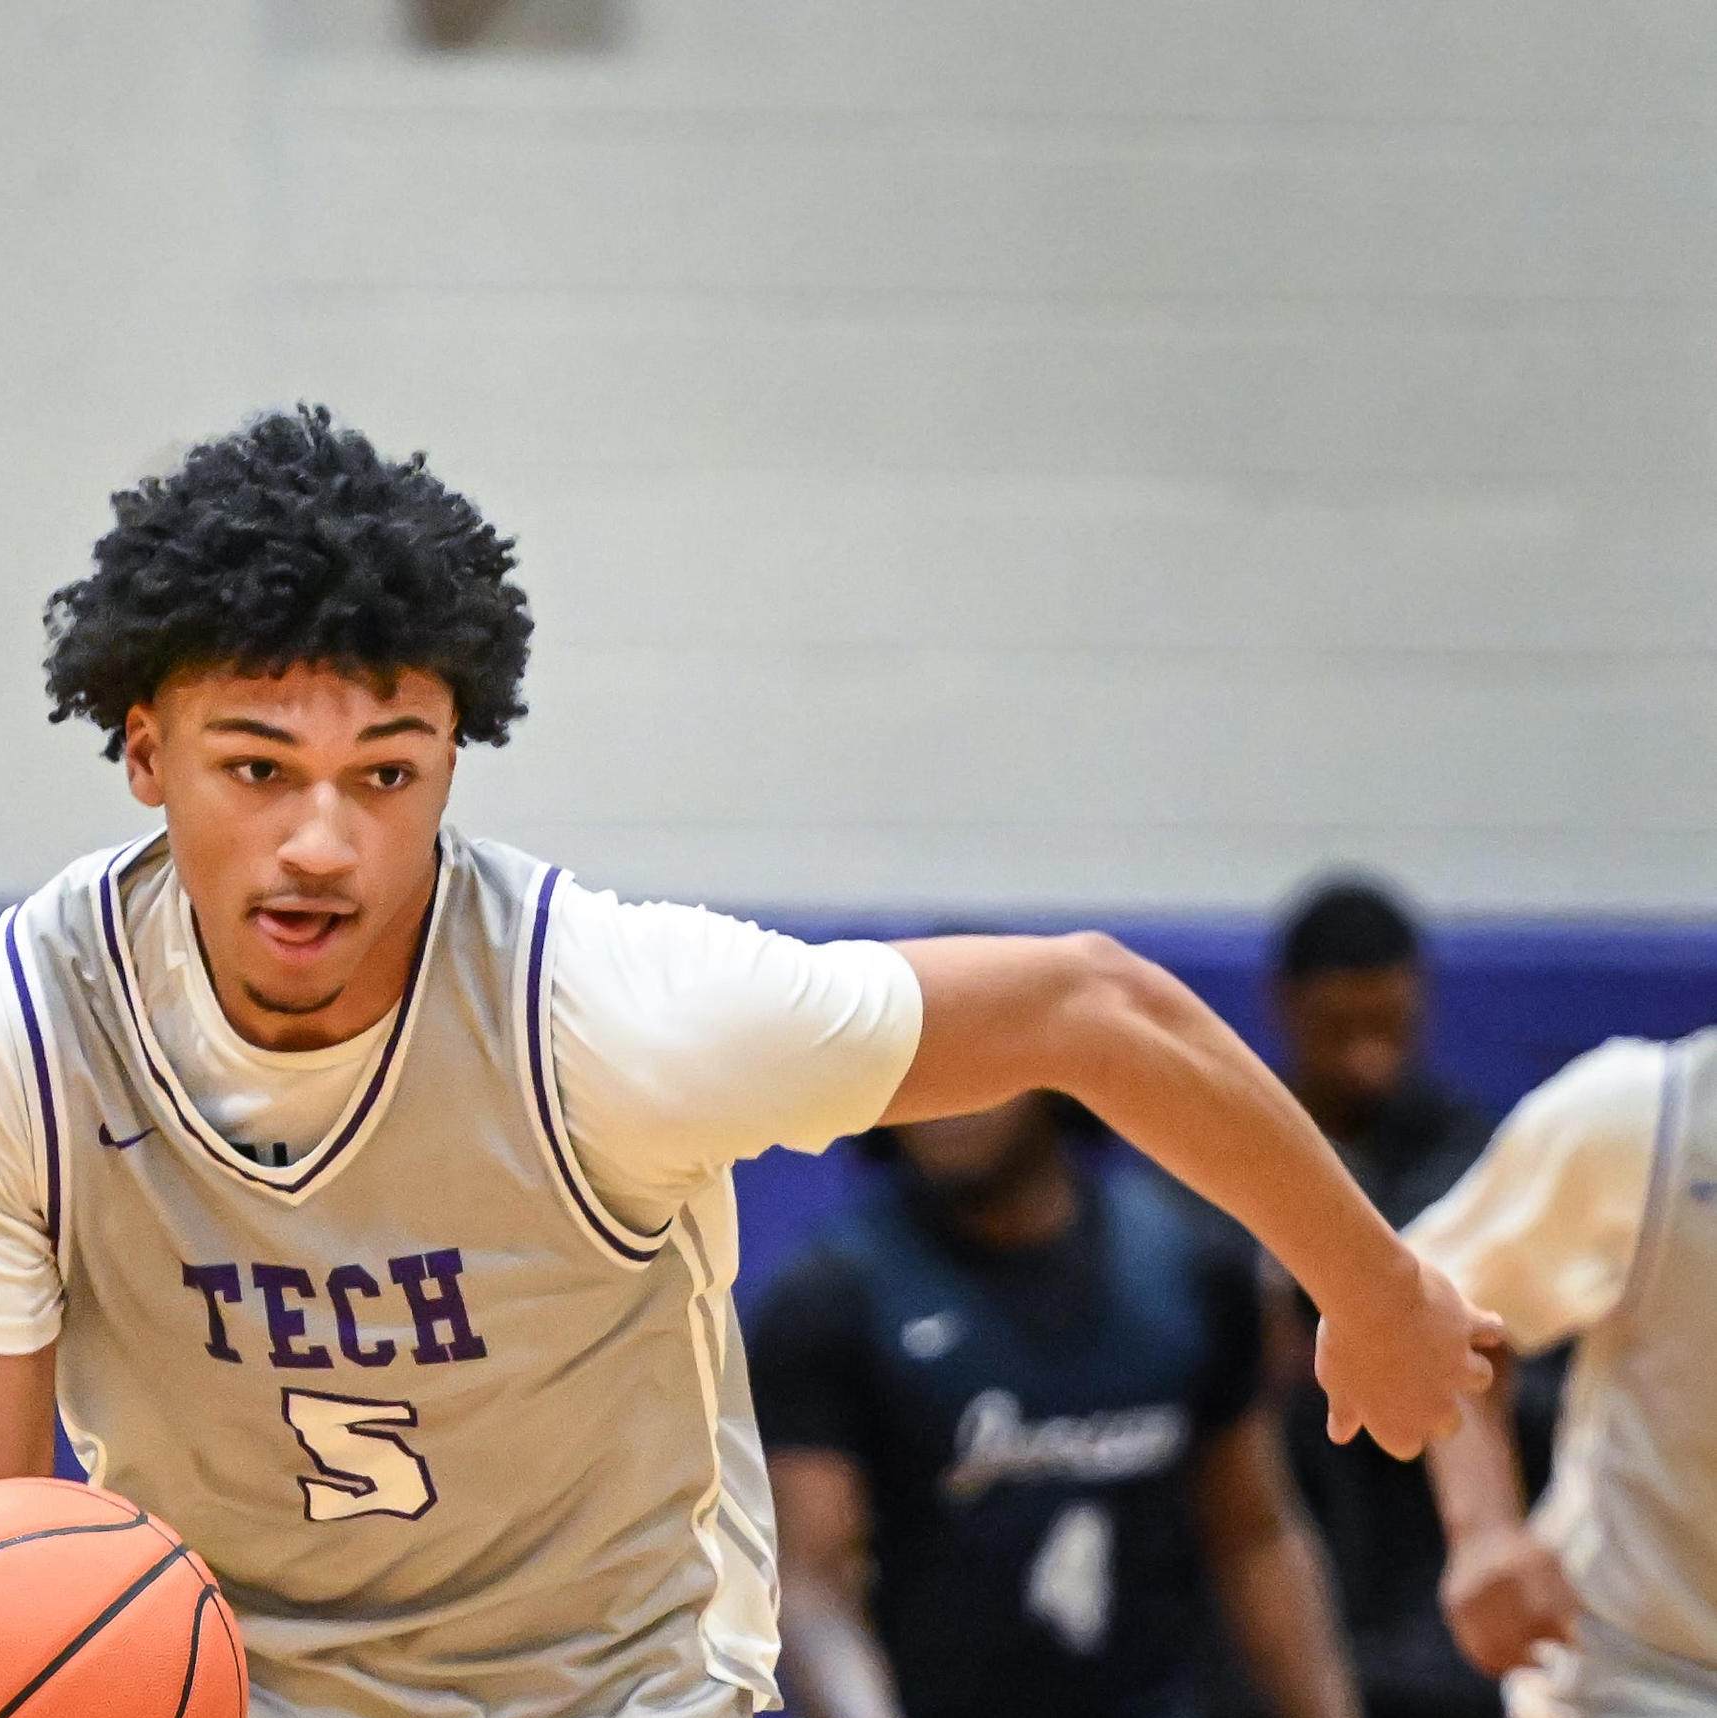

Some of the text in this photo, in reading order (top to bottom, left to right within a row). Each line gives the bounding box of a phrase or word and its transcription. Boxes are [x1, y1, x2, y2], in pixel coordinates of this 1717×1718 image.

[182, 1247, 488, 1370] TECH
[280, 1386, 439, 1522] 5
[1026, 1501, 1114, 1653] 4
